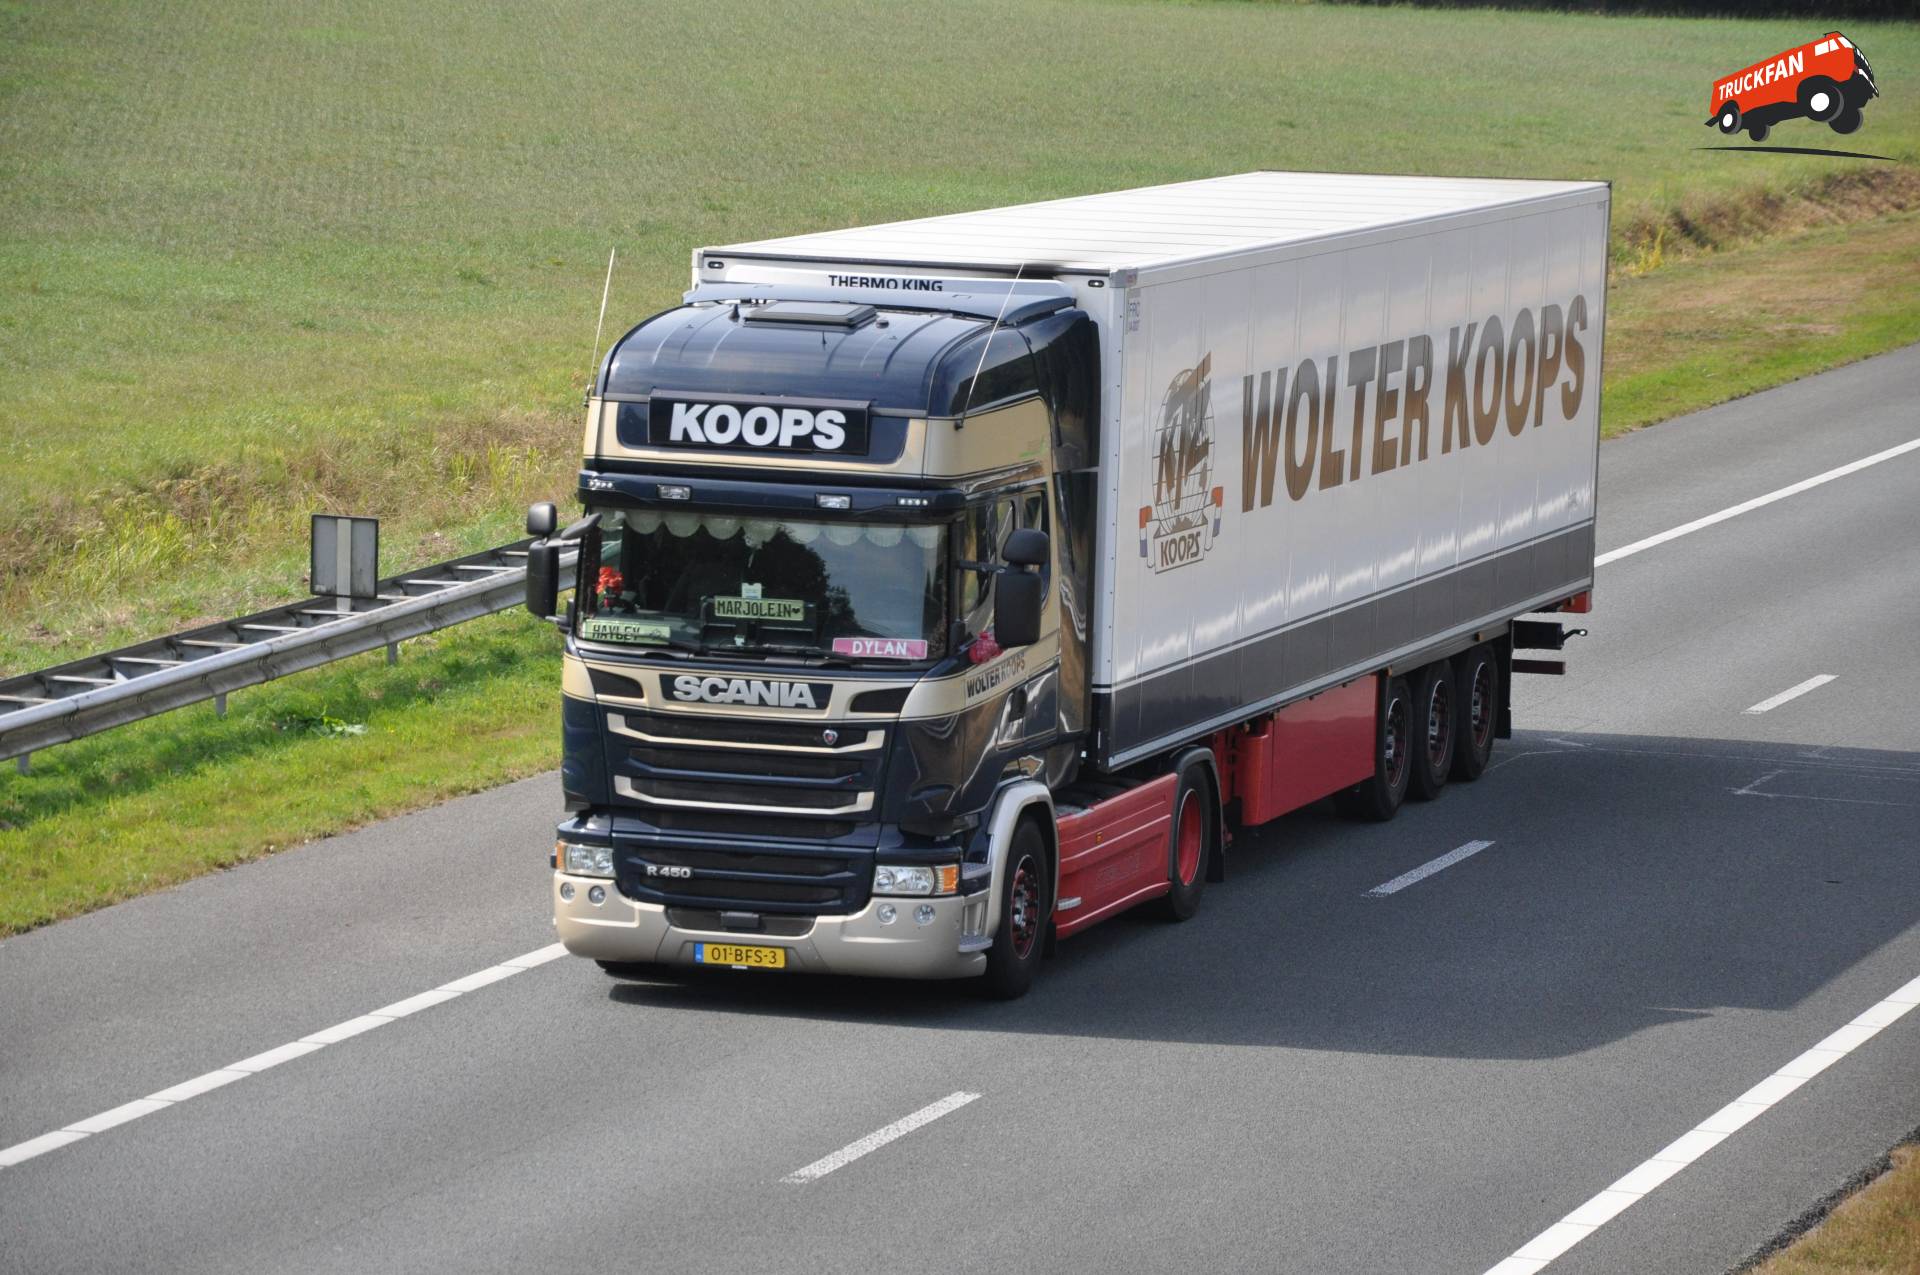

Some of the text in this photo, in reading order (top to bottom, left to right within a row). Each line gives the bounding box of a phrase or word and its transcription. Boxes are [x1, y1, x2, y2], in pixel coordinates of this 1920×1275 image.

[828, 274, 943, 292] THERMO KING
[1242, 294, 1588, 513] WOLTER KOOPS
[669, 402, 847, 450] KOOPS
[1160, 531, 1201, 568] KOOPS
[716, 600, 791, 617] MARJOLEIN
[852, 640, 907, 656] DYLAN
[966, 653, 1026, 698] WOLTER KOOPS
[673, 675, 816, 708] SCANIA
[646, 866, 691, 878] R 450
[711, 947, 777, 964] 01-BFS-3
